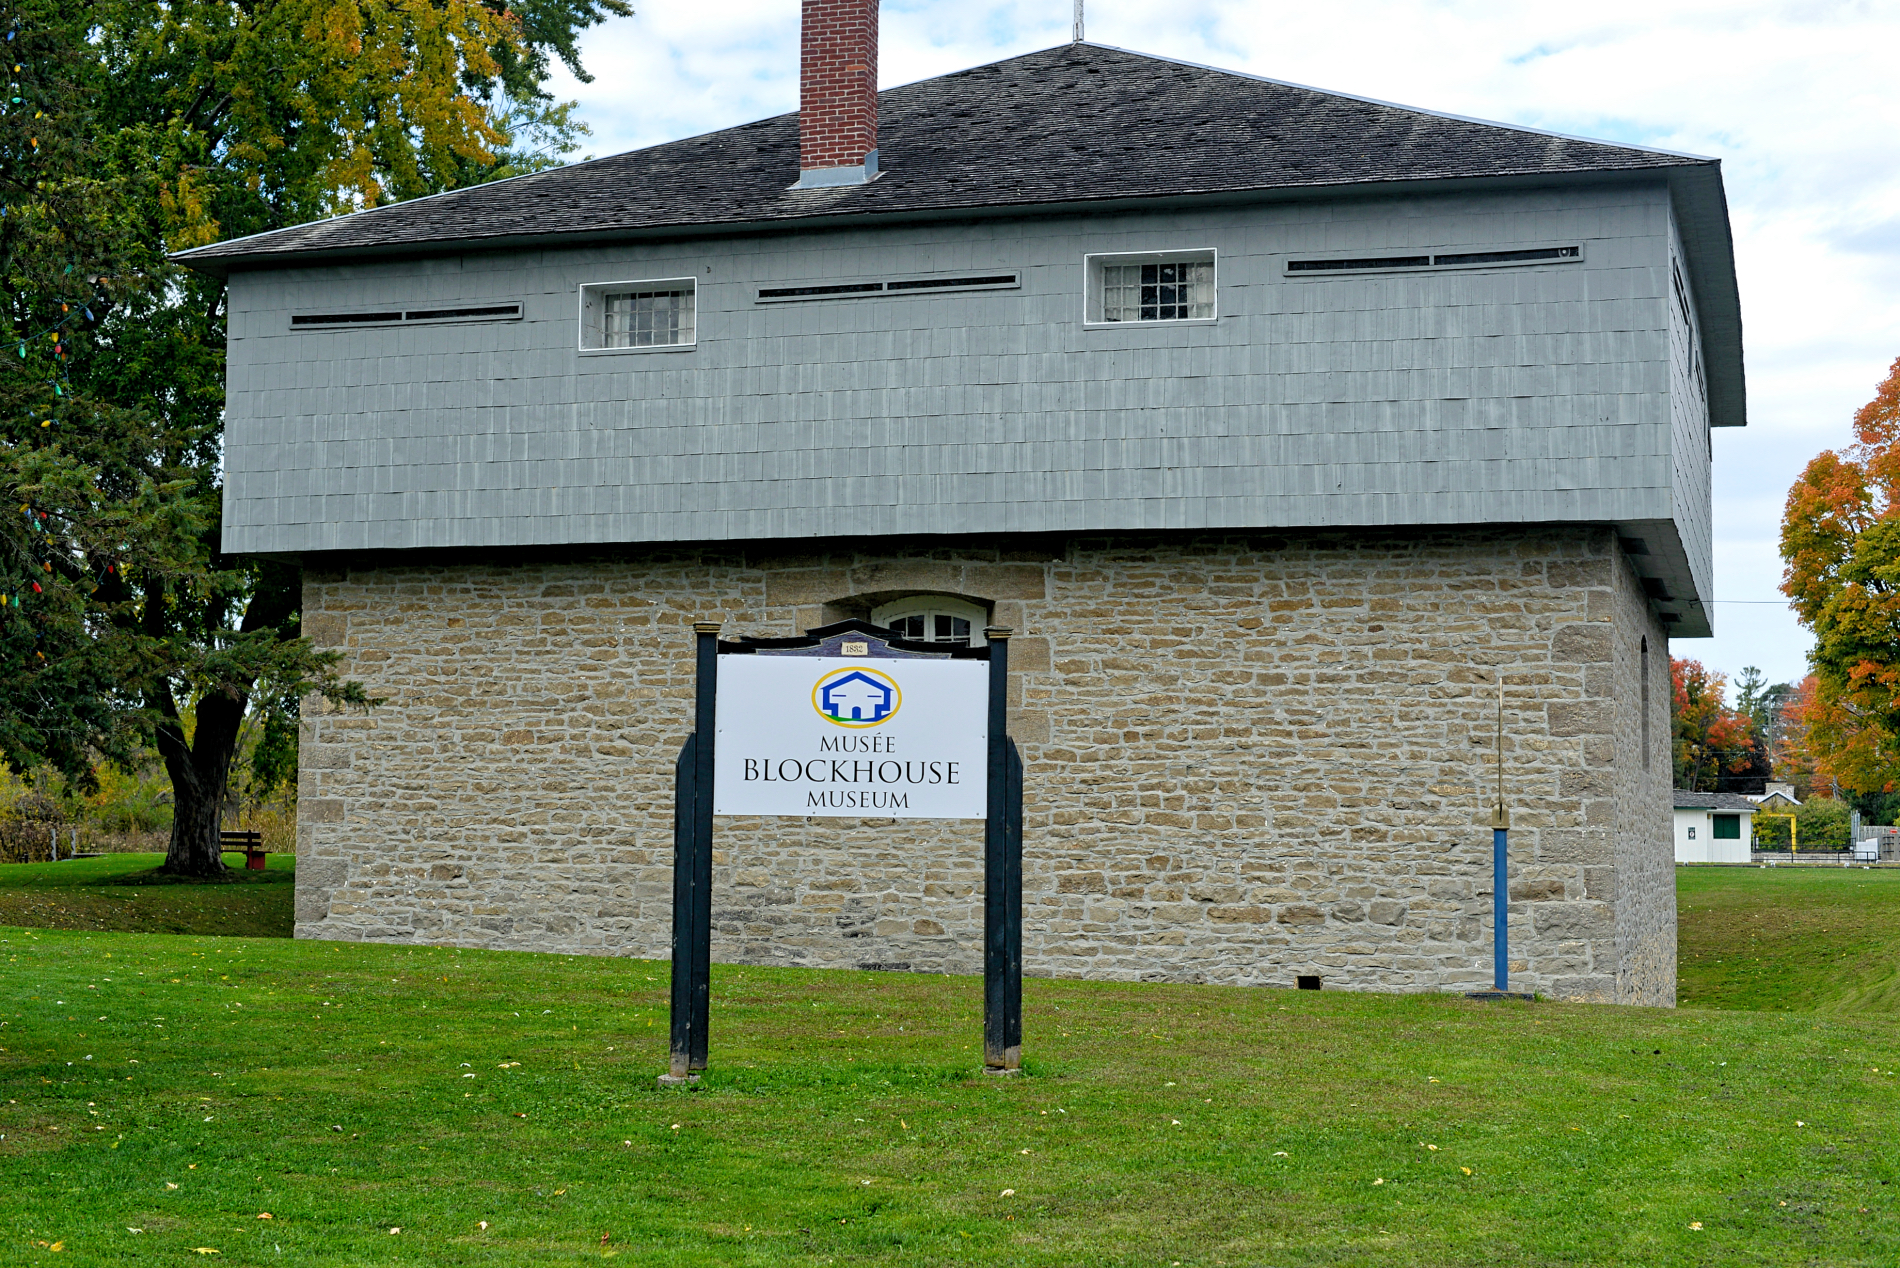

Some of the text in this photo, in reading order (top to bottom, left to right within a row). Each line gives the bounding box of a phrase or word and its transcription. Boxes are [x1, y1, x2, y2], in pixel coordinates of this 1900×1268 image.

[845, 645, 864, 654] 1832
[820, 732, 896, 753] MUSÉE
[743, 758, 960, 785] BLOCKHOUSE
[806, 790, 909, 809] MUSEUM
